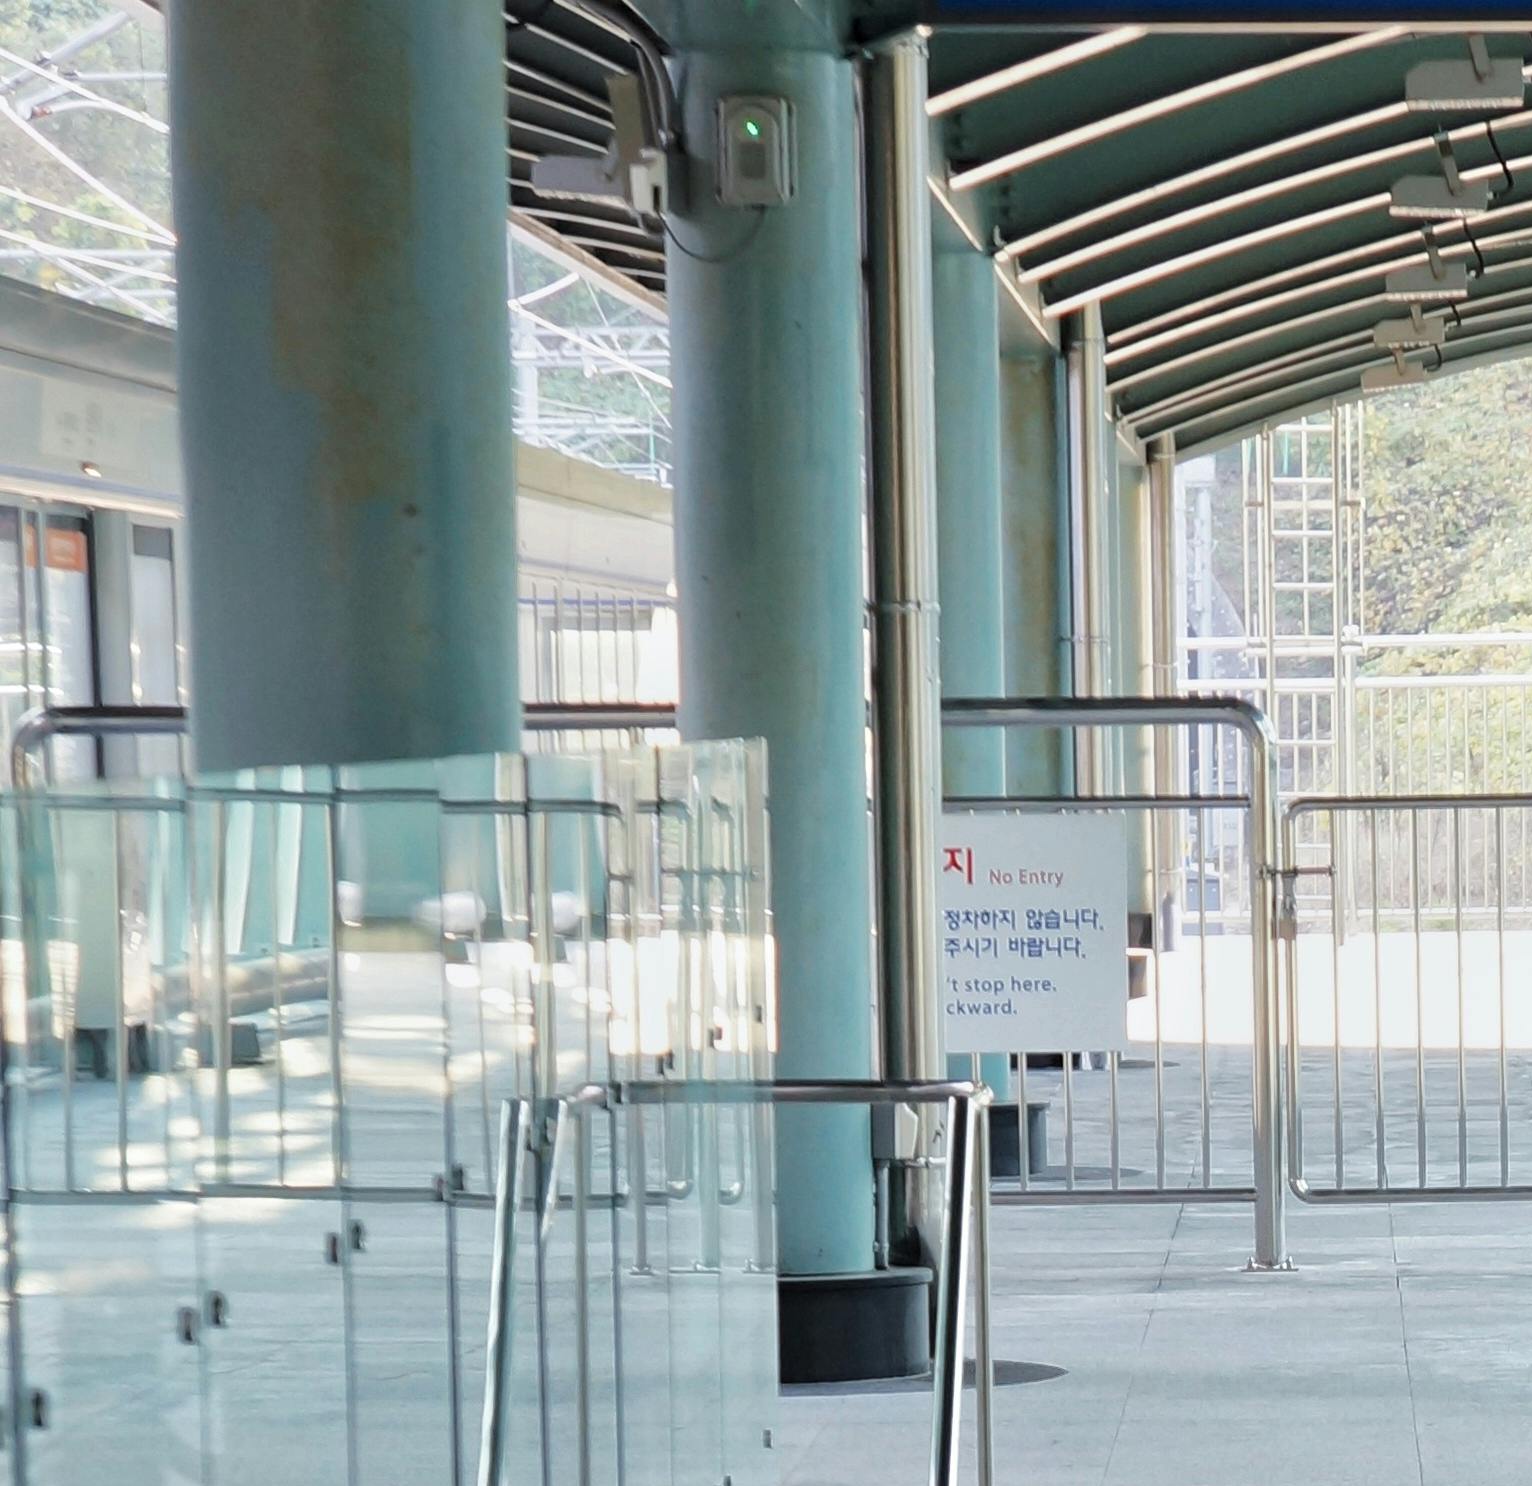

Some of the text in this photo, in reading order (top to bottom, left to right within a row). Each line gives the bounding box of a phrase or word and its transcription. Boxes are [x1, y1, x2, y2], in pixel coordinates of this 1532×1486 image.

[943, 847, 973, 884] 지
[989, 868, 1064, 888] No Entry
[944, 908, 1104, 930] 정차하지 않습니다.
[944, 936, 1087, 958] 주시기 바랍니다.
[964, 979, 1004, 996] stop
[1010, 975, 1057, 993] here.
[946, 999, 1018, 1016] ckward.
